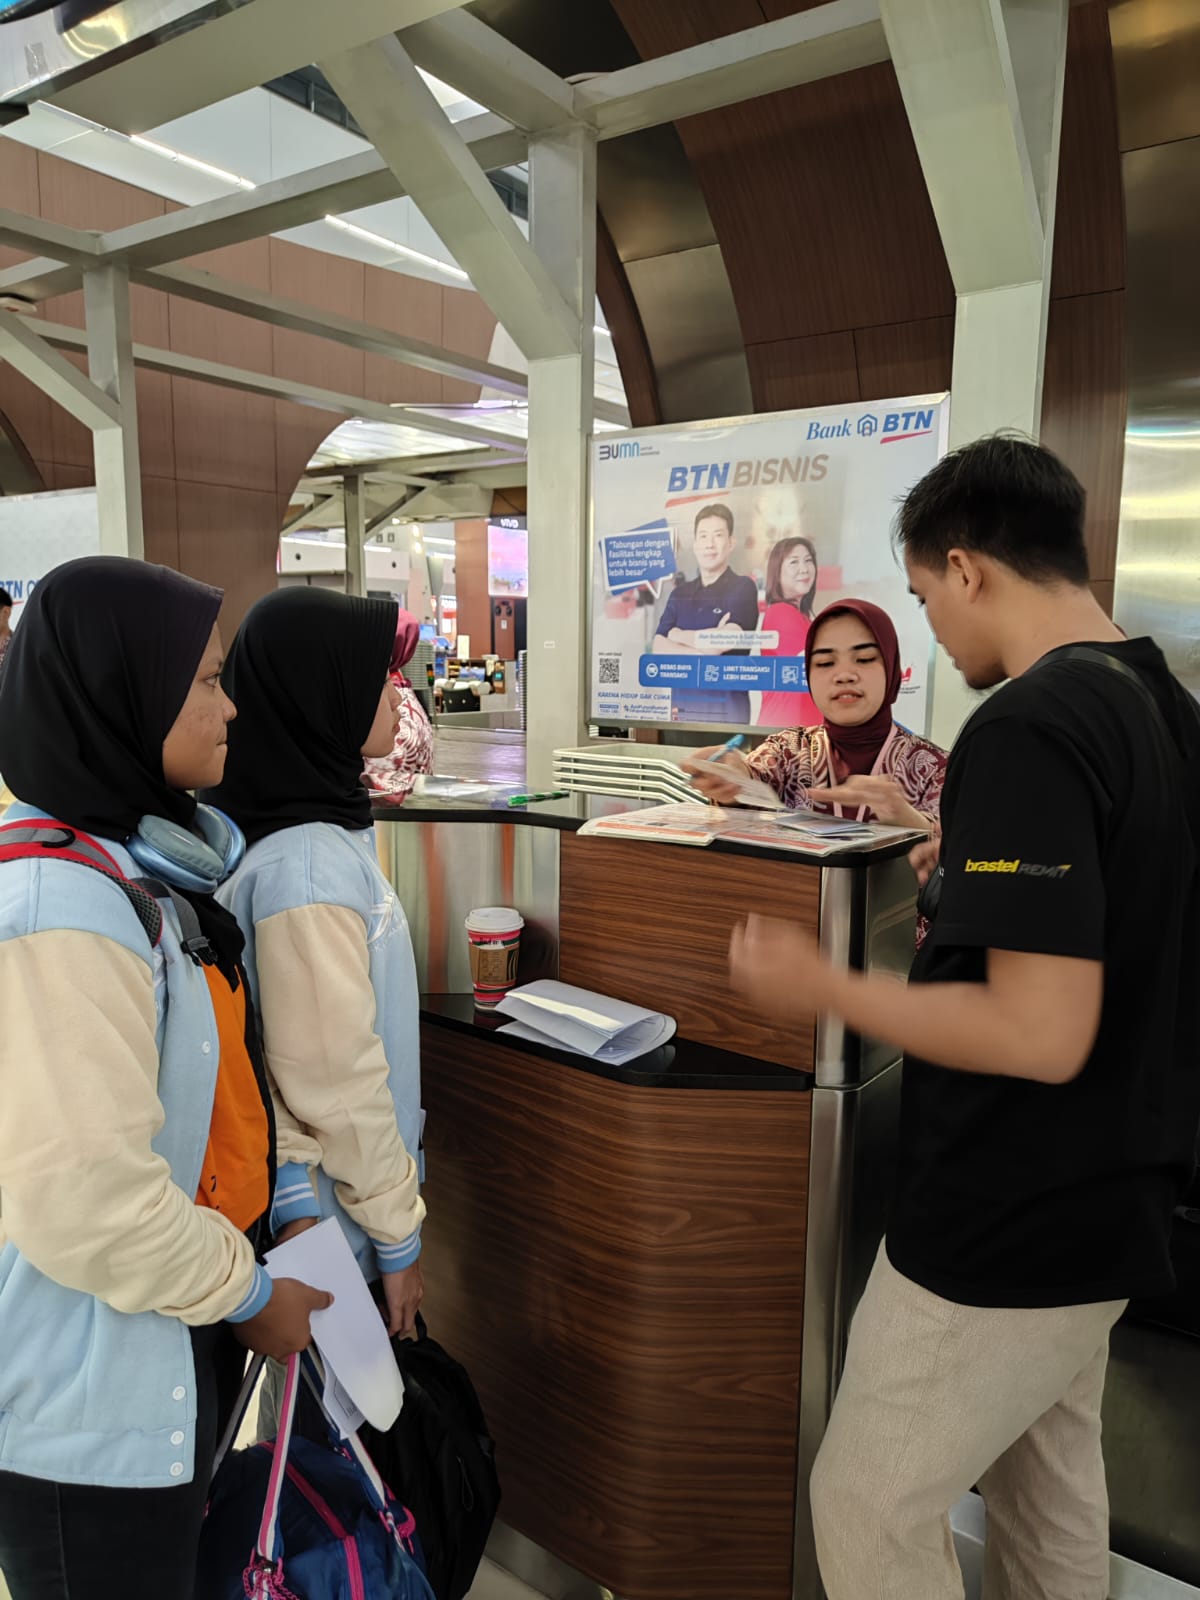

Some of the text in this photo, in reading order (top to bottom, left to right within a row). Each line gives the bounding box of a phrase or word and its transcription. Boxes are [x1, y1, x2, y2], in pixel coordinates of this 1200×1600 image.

[806, 410, 934, 440] Bank BTN
[599, 442, 640, 461] BUMN
[668, 454, 830, 492] BTN BISNIS
[609, 559, 627, 567] untuk
[608, 568, 625, 576] lebih
[965, 859, 1020, 873] brastel
